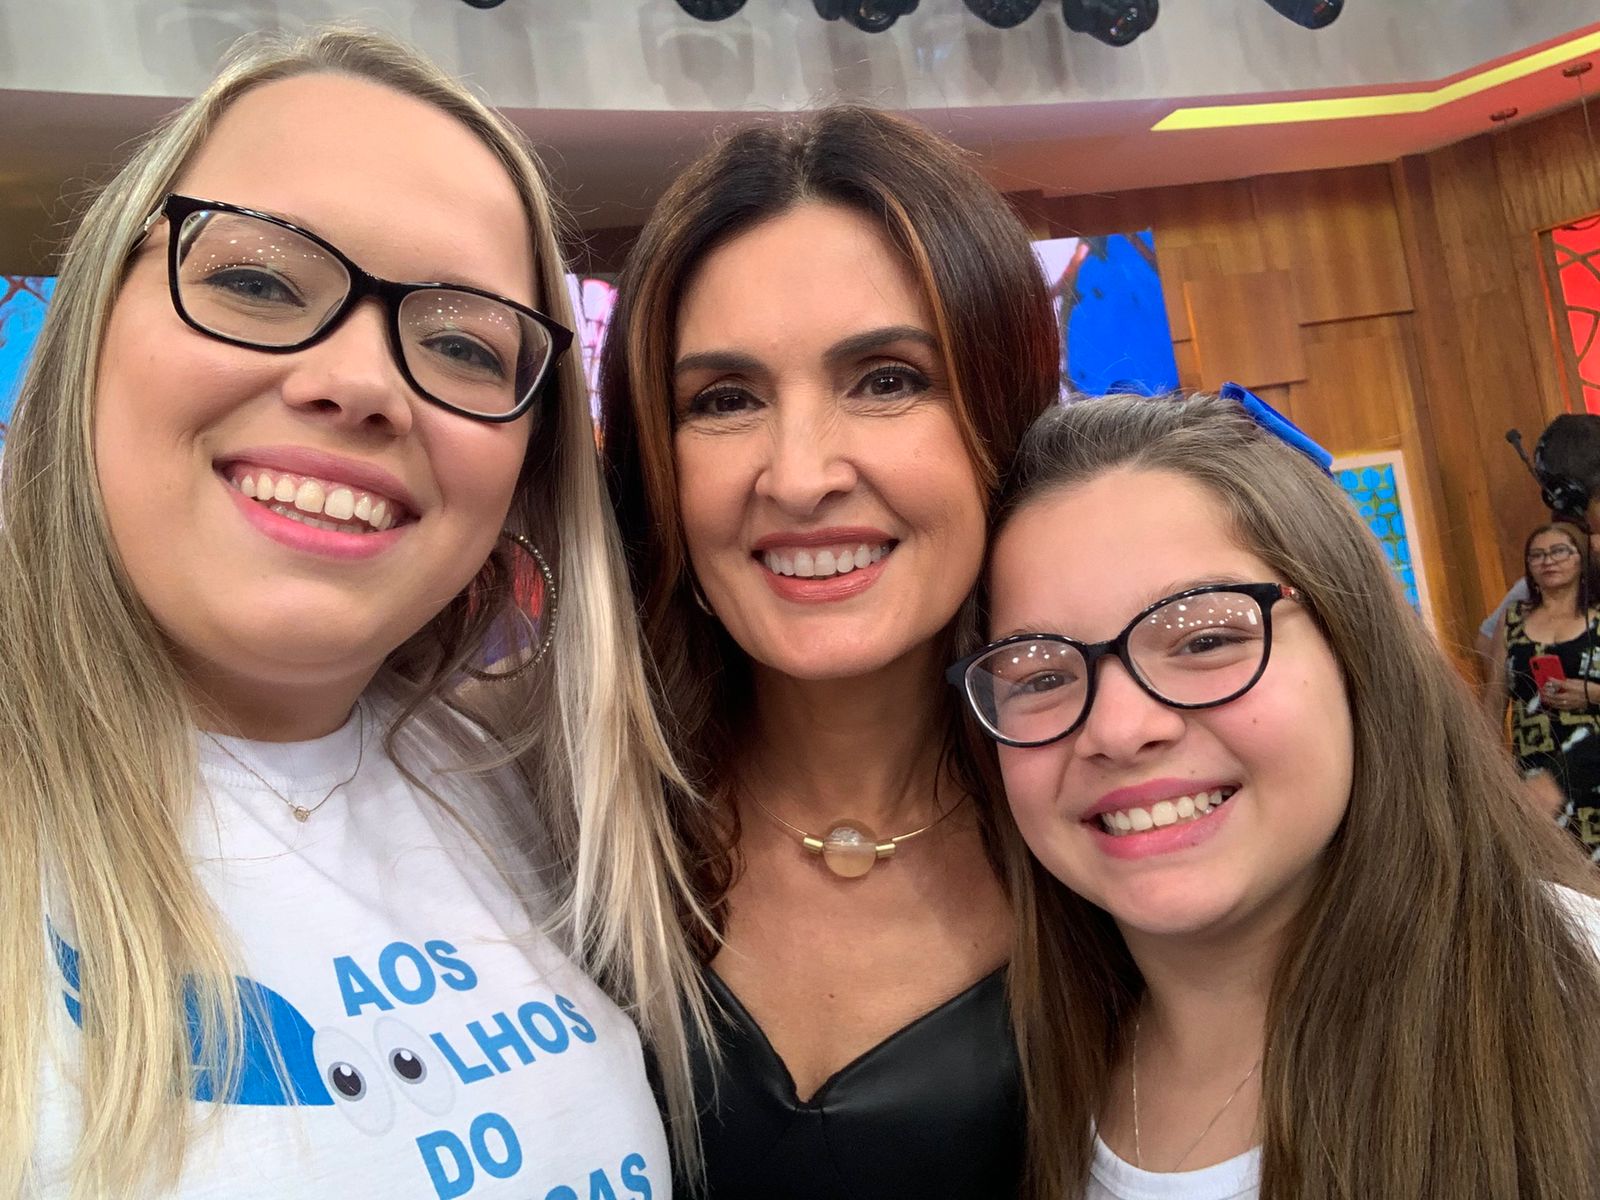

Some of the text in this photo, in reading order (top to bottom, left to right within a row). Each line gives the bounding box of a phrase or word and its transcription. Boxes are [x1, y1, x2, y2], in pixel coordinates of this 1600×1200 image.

[332, 939, 479, 1018] AOS
[415, 1111, 524, 1200] DO
[543, 1152, 653, 1200] AS
